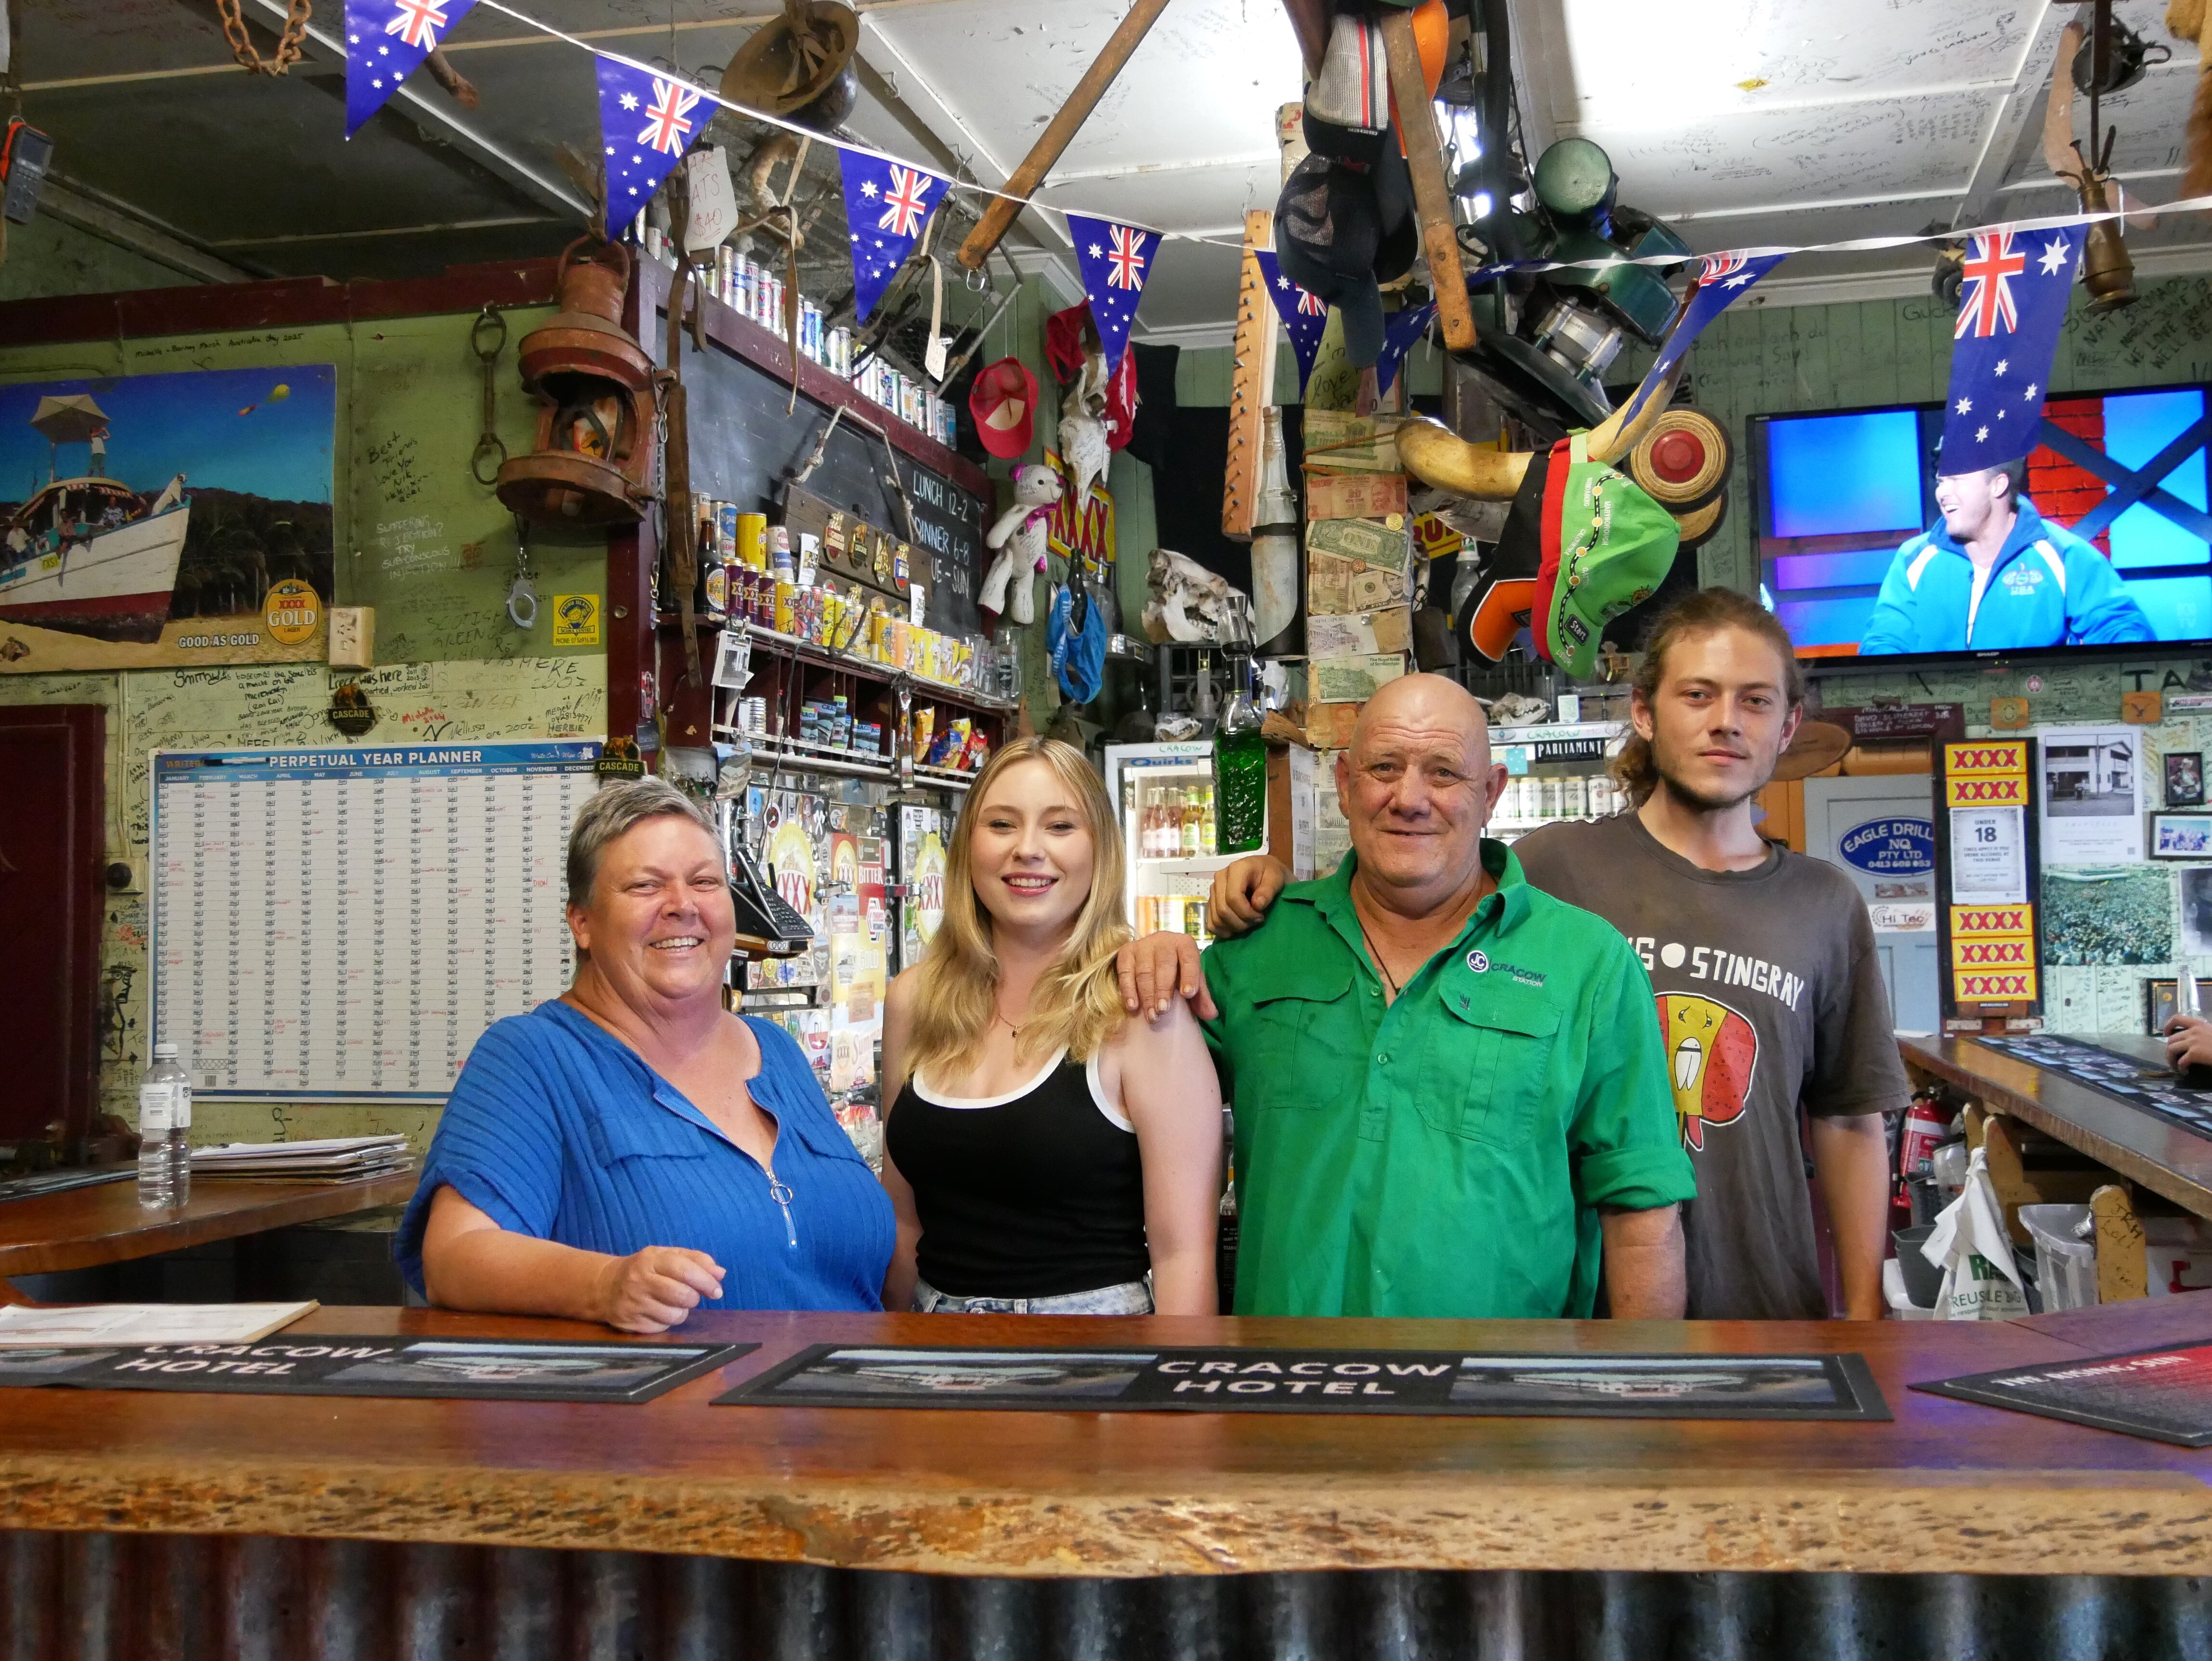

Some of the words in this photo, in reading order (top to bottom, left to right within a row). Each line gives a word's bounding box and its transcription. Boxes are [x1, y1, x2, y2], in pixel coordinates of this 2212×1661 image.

[693, 208, 722, 237] $40
[913, 470, 943, 507] LUNCH
[1601, 501, 1611, 546] MARYBOROUGH
[914, 515, 949, 554] DINNER
[952, 565, 969, 599] SUN
[278, 599, 306, 609] XXXX
[268, 609, 316, 626] GOLD
[1570, 620, 1586, 640] Start
[178, 636, 209, 648] GOOD
[212, 635, 228, 647] AS
[229, 634, 260, 646] GOLD
[519, 657, 580, 675] HERE
[379, 669, 403, 683] here
[393, 683, 417, 692] worked
[332, 710, 370, 719] CASCADE
[506, 723, 540, 733] 2002
[548, 723, 585, 732] HERBIE
[1527, 729, 1580, 739] CRACOW
[1538, 740, 1603, 758] PARLIAMENT
[269, 753, 357, 768] PERPETUAL
[362, 752, 403, 766] YEAR
[408, 751, 482, 764] PLANNER
[599, 762, 640, 772] CASCADE
[1130, 757, 1192, 767] Quirks
[1953, 749, 2018, 768] XXXX
[1954, 780, 2020, 801] XXXX
[1843, 823, 1889, 853] EAGLE
[1975, 827, 1997, 843] 18
[1888, 838, 1912, 850] NQ
[1879, 850, 1898, 859] PTY
[1904, 850, 1922, 859] LTD
[858, 865, 884, 885] BITTER
[1959, 911, 2024, 931] XXXX
[1470, 953, 1486, 967] JC
[1960, 943, 2026, 962] XXXX
[1491, 962, 1548, 982] CRACOW
[1689, 947, 1806, 1012] STINGRAY
[1512, 976, 1543, 988] STATION
[1962, 976, 2028, 995] XXXX
[114, 1358, 297, 1375] HOTEL
[1157, 1361, 1451, 1376] CRACOW
[2131, 1354, 2192, 1368] SUN
[1173, 1380, 1396, 1395] HOTEL
